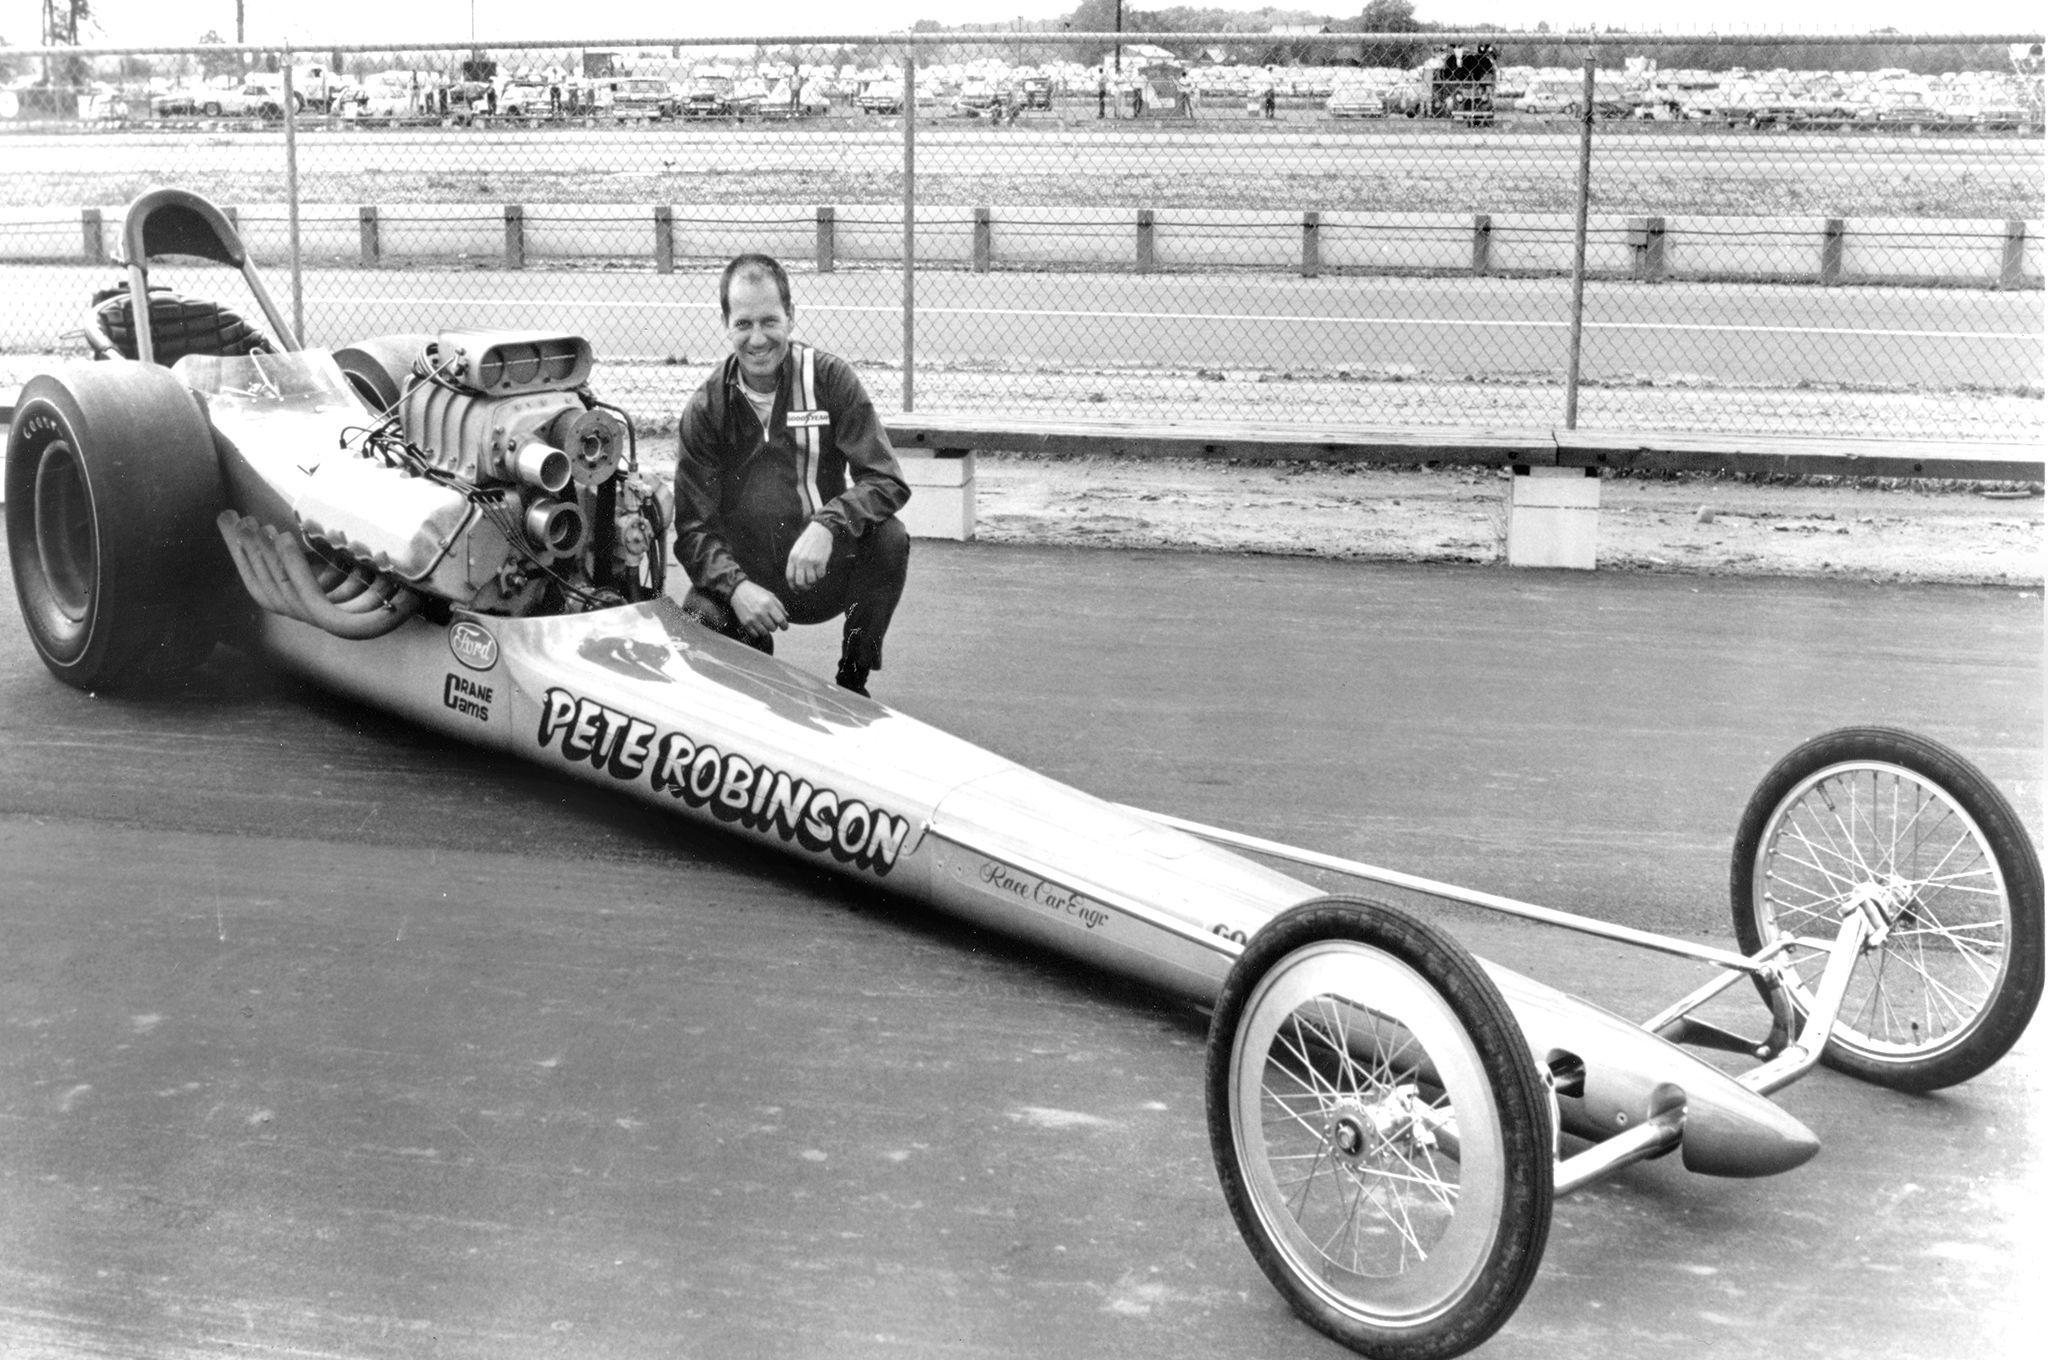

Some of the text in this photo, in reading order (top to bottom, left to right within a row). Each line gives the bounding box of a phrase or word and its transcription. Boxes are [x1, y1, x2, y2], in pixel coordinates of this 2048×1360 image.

[453, 627, 493, 661] Ford
[444, 673, 493, 708] CRANE
[444, 673, 489, 722] Cams
[538, 687, 909, 877] PETE ROBINSON
[980, 861, 1031, 899] Race
[1034, 880, 1065, 909] Car
